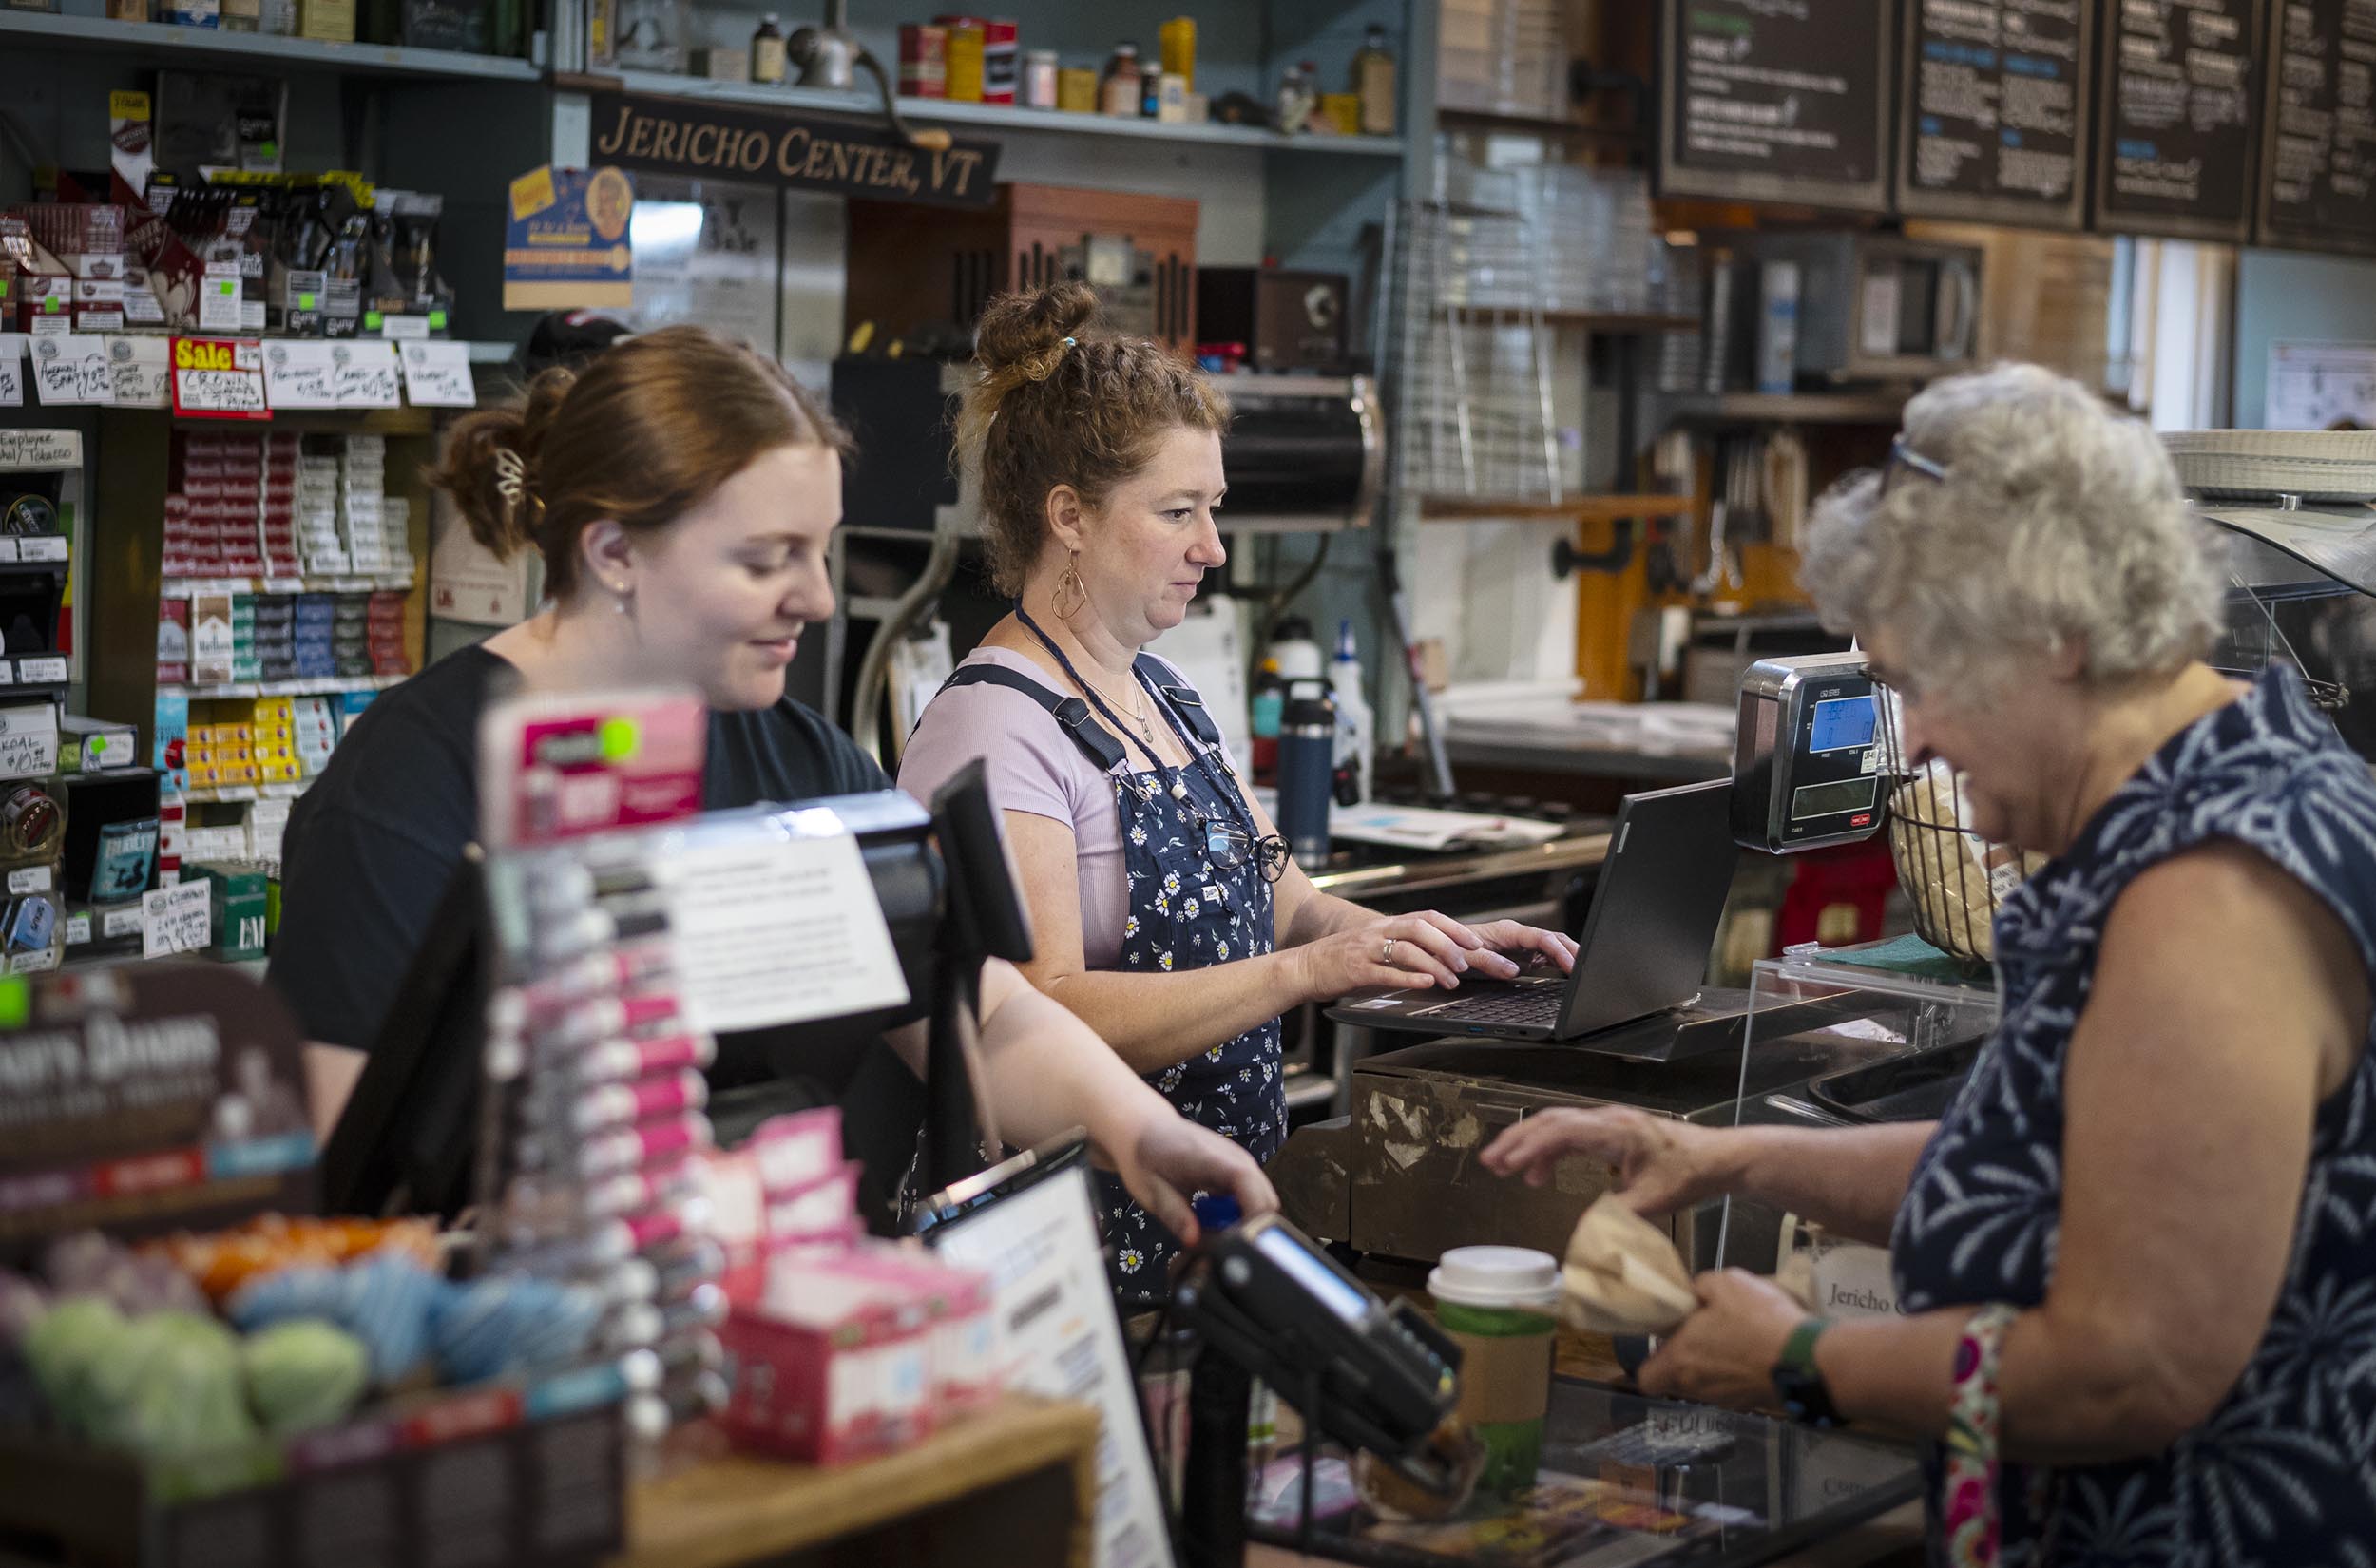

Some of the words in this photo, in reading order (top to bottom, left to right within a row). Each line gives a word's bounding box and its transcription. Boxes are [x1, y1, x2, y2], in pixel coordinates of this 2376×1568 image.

[598, 105, 770, 172] JERICHO
[777, 127, 920, 195] CENTER,
[930, 148, 984, 196] VT
[176, 338, 231, 370] Sale
[0, 736, 39, 754] KOAL
[1828, 1283, 1890, 1312] Jericho
